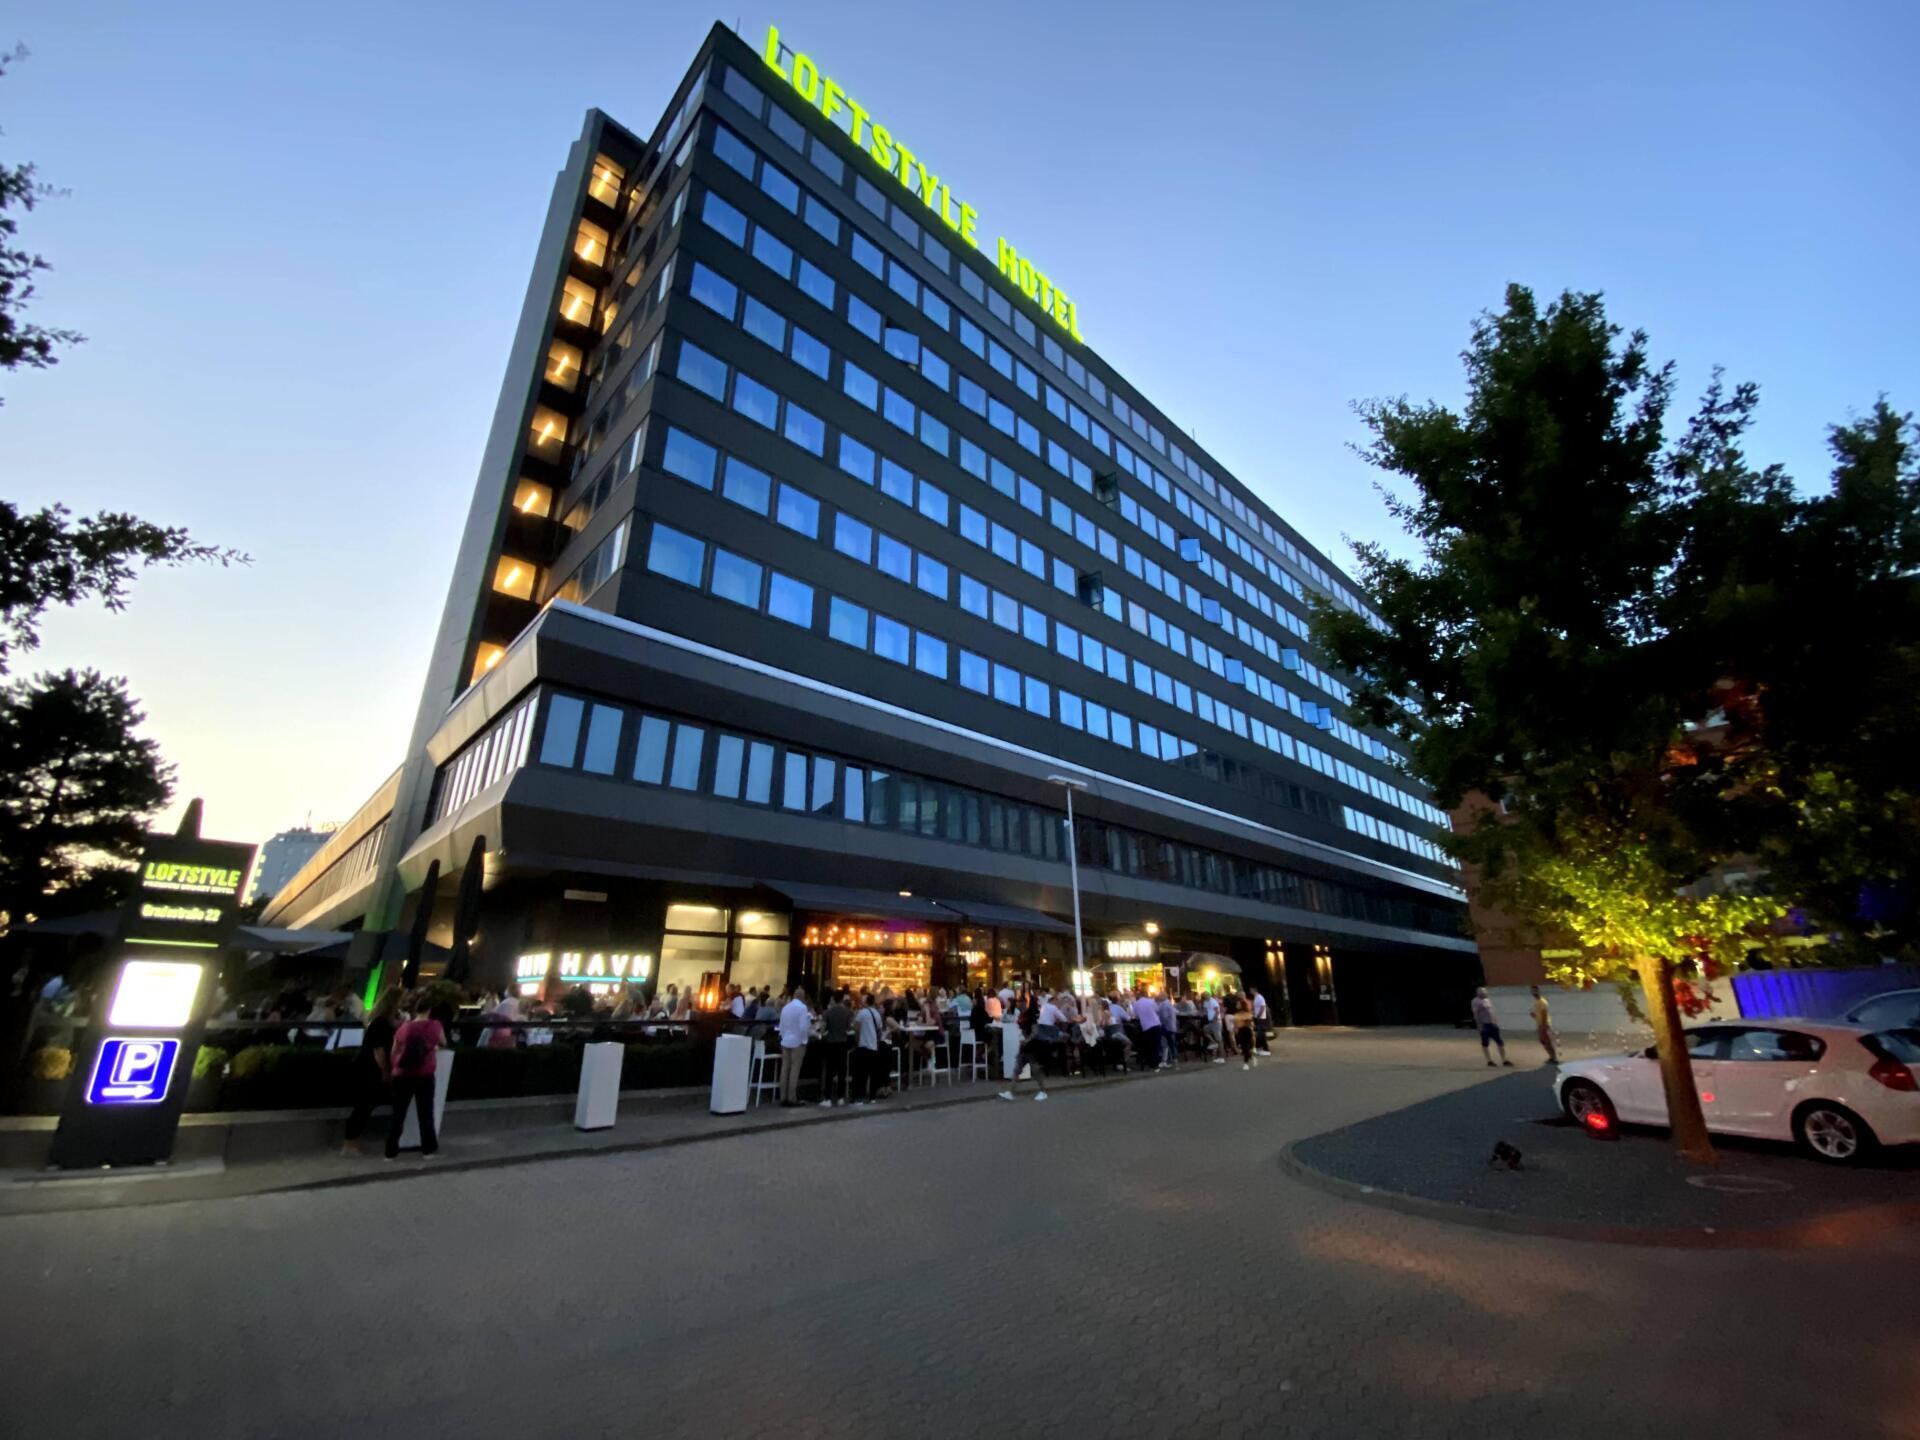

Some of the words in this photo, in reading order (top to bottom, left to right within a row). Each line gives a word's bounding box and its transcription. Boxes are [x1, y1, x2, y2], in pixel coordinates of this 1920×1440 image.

[763, 25, 980, 248] LOFTSTYLE
[997, 237, 1085, 344] HOTEL
[145, 862, 241, 888] LOFTSTYLE
[560, 953, 651, 977] HAVN
[119, 1044, 158, 1082] P
